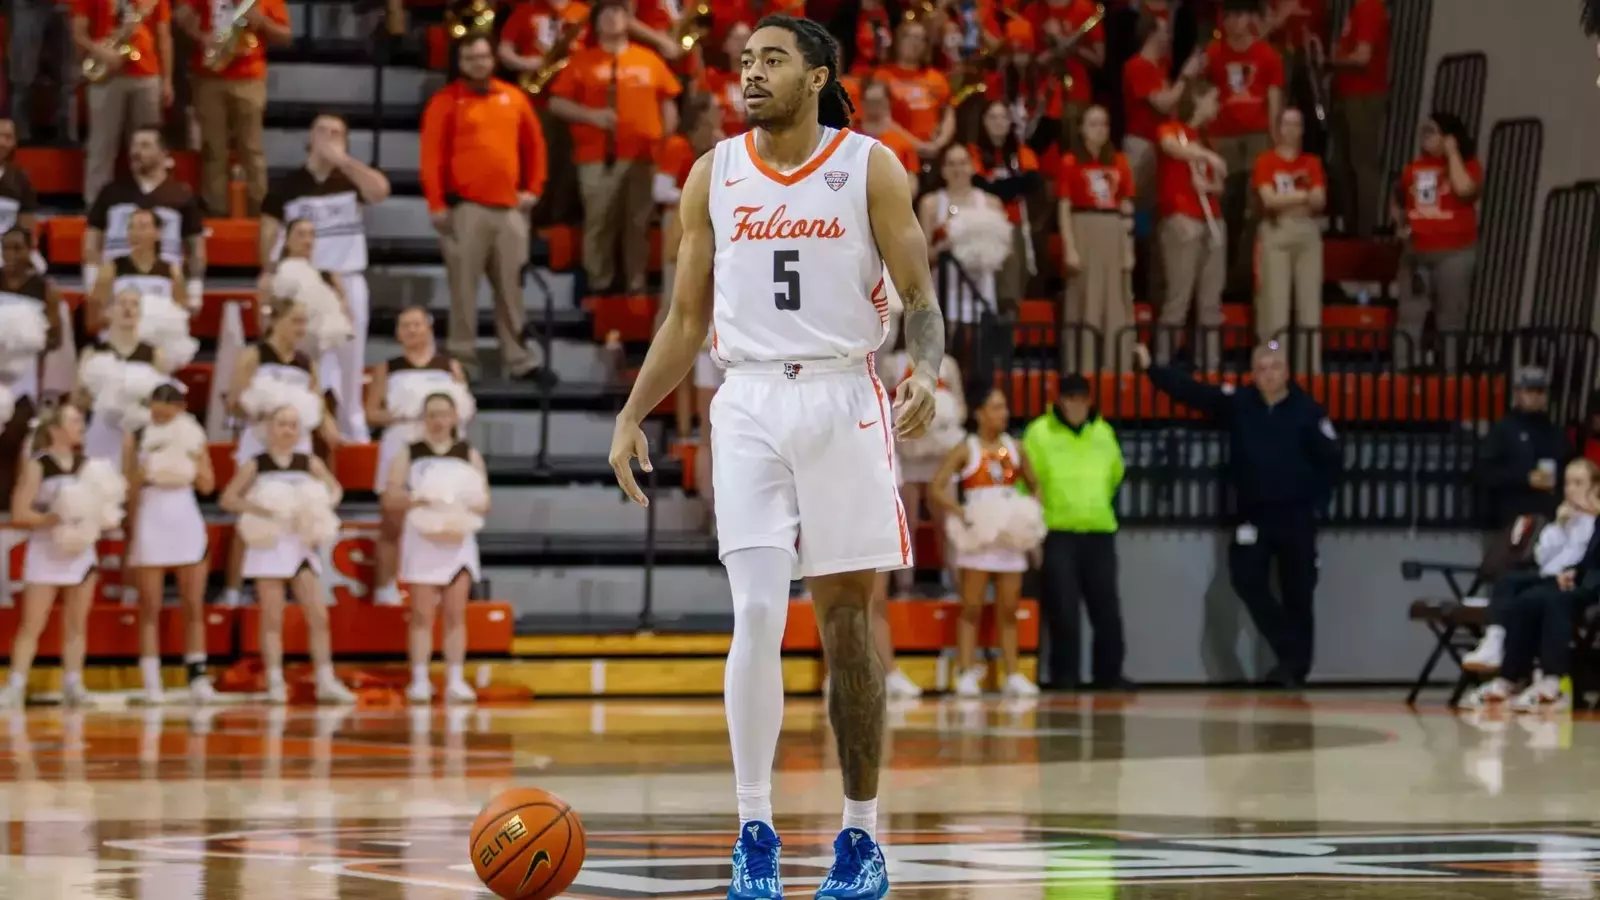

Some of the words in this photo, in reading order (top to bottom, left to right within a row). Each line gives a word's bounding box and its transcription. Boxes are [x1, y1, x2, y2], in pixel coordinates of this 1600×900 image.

[730, 204, 846, 242] Falcons
[773, 249, 801, 311] 5
[479, 820, 528, 868] ELITE
